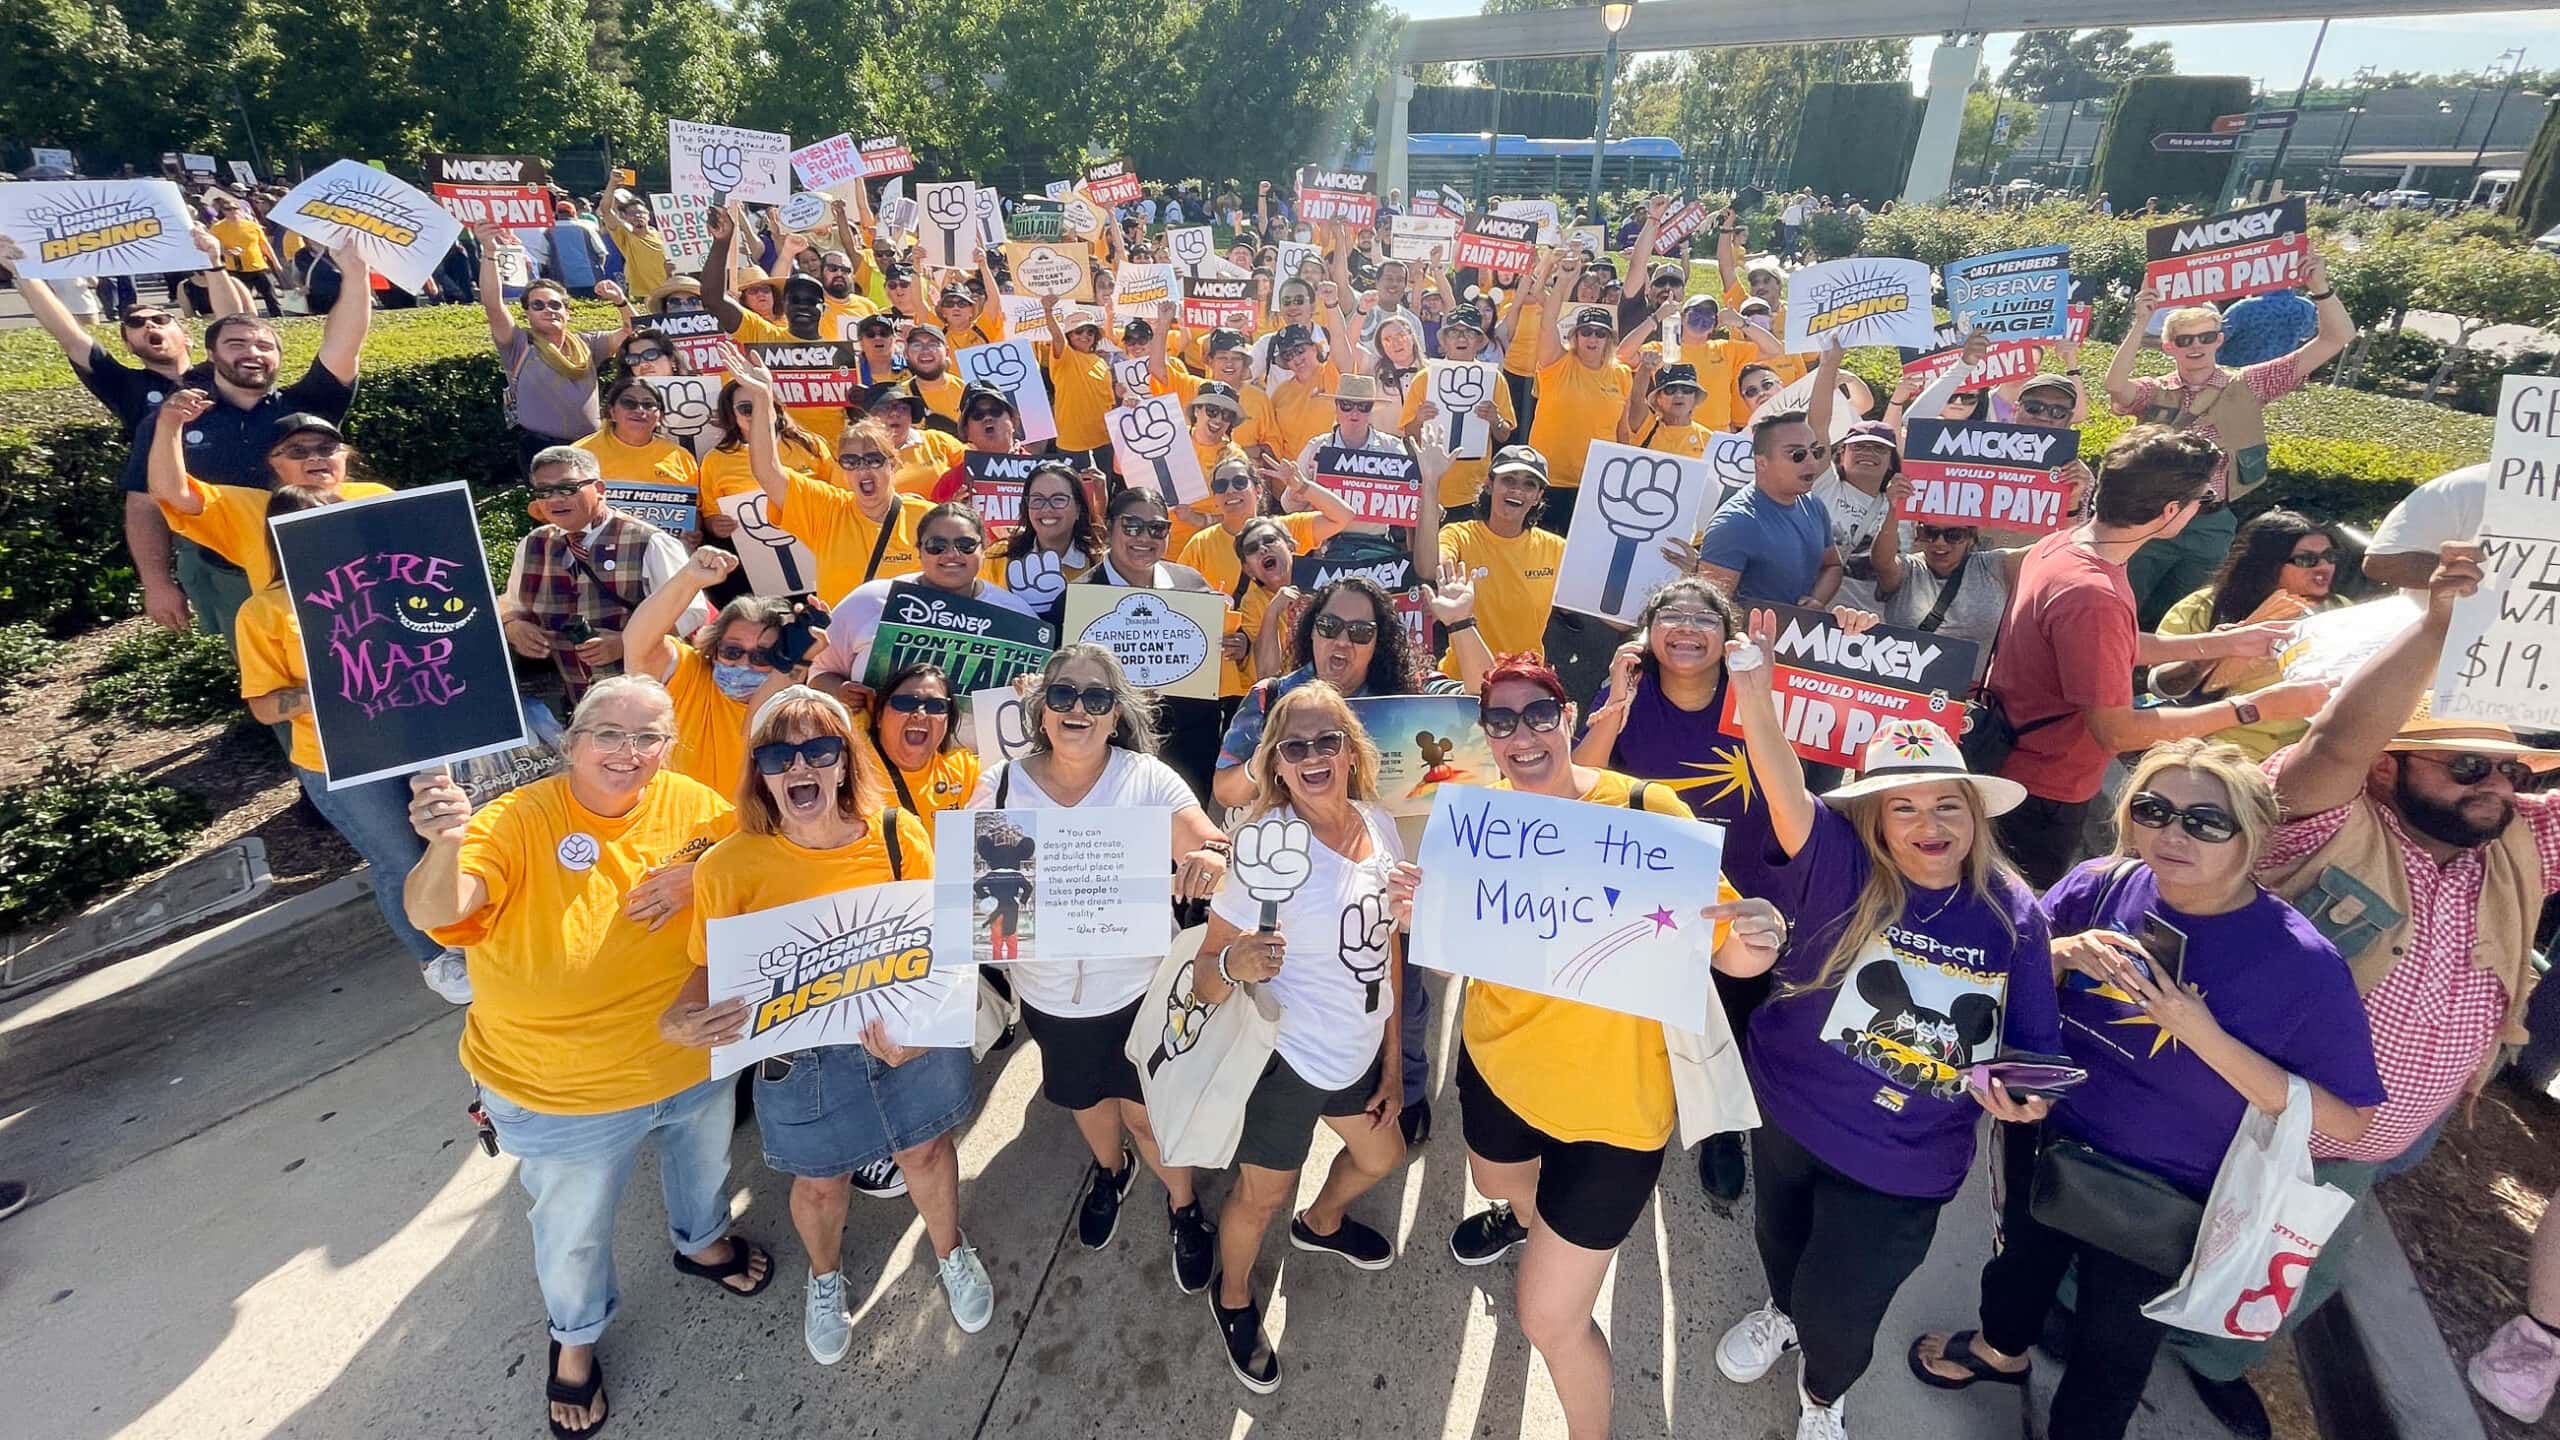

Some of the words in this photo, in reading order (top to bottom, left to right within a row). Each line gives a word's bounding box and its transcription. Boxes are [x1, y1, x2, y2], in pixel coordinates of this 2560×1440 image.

[793, 144, 830, 166] WHEN
[830, 136, 851, 152] WE
[862, 134, 898, 152] MICKEY
[442, 159, 524, 182] MICKEY
[806, 151, 849, 174] FIGHT
[1090, 161, 1123, 180] MICKEY
[806, 175, 825, 190] WE
[827, 164, 857, 181] WIN
[1314, 170, 1368, 190] MICKEY
[61, 201, 130, 224] DISNEY
[64, 207, 155, 236] WORKERS
[441, 196, 488, 223] FAIR
[489, 199, 548, 224] PAY!
[656, 210, 707, 229] WORK
[1303, 200, 1336, 219] FAIR
[1337, 201, 1372, 225] PAY!
[299, 202, 417, 246] RISING
[663, 225, 707, 242] DESE
[1476, 217, 1530, 239] MICKEY
[2171, 209, 2283, 253] MICKEY
[42, 219, 161, 263] RISING
[669, 240, 714, 257] BETT
[1461, 244, 1496, 265] FAIR
[1495, 249, 1530, 270] PAY!
[1970, 264, 1997, 279] CAST
[1997, 255, 2059, 274] MEMBERS
[2186, 252, 2231, 267] WOULD
[2234, 245, 2271, 259] WANT
[2155, 266, 2226, 302] FAIR
[2231, 250, 2300, 290] PAY!
[1119, 286, 1167, 304] RISING
[1193, 281, 1247, 298] MICKEY
[1831, 284, 1906, 309] WORKERS
[1832, 277, 1892, 301] DISNEY
[1949, 274, 2059, 304] DESERVE
[1186, 307, 1217, 326] FAIR
[1220, 309, 1254, 327] P!
[1807, 294, 1908, 335] RISING
[1991, 298, 2055, 314] Living
[650, 315, 720, 337] MICKEY
[1972, 315, 2055, 333] WAGE!
[765, 346, 838, 367] MICKEY
[1932, 352, 1963, 366] WOUL
[1971, 347, 2028, 384] PAY!
[1931, 427, 2057, 463] MICKEY
[1334, 453, 1413, 478] MICKEY
[1944, 466, 1996, 480] WOULD
[1998, 471, 2036, 484] WANT
[604, 489, 633, 501] CAST
[633, 490, 689, 504] MEMBERS
[1342, 479, 1373, 490] WOULD
[1374, 482, 1400, 491] WANT
[1369, 491, 1419, 521] PAY!
[1905, 479, 1985, 518] FAIR
[1990, 484, 2062, 527] PAY!
[304, 553, 464, 610] WE'RE
[329, 588, 395, 643] ALL
[896, 593, 992, 636] DISNEY
[2500, 590, 2560, 625] WA
[1143, 630, 1159, 640] MY
[895, 631, 970, 651] DON'T
[970, 642, 999, 656] BE
[1000, 648, 1043, 665] THE
[1113, 642, 1136, 653] BUT
[1140, 642, 1174, 652] CAN'T
[1149, 654, 1163, 665] TO
[1165, 654, 1190, 665] EAT!
[1774, 617, 1943, 684] MICKEY
[328, 637, 453, 701] MAD
[2457, 635, 2550, 691] $19.
[356, 658, 466, 721] HERE
[1788, 674, 1855, 699] WOULD
[1856, 689, 1910, 710] WANT
[513, 757, 560, 777] PARK
[1043, 840, 1073, 850] design
[1075, 840, 1091, 848] and
[1448, 801, 1566, 860] We're
[1595, 824, 1675, 872] the
[1043, 852, 1060, 860] and
[1062, 851, 1084, 860] build
[1086, 851, 1101, 859] the
[1103, 851, 1125, 859] most
[1043, 863, 1087, 872] wonderful
[1089, 863, 1114, 872] place
[1049, 876, 1063, 884] the
[1065, 875, 1093, 883] world.
[1096, 874, 1111, 882] But
[1049, 887, 1073, 895] takes
[1074, 886, 1107, 896] people
[1045, 899, 1069, 907] make
[1087, 897, 1115, 906] dream
[1477, 878, 1622, 939] Magic!
[1097, 922, 1128, 935] Disney
[799, 918, 903, 968] DISNEY
[1886, 925, 1985, 965] RESPECT!
[799, 929, 930, 984] WORKERS
[754, 948, 932, 1034] RISING
